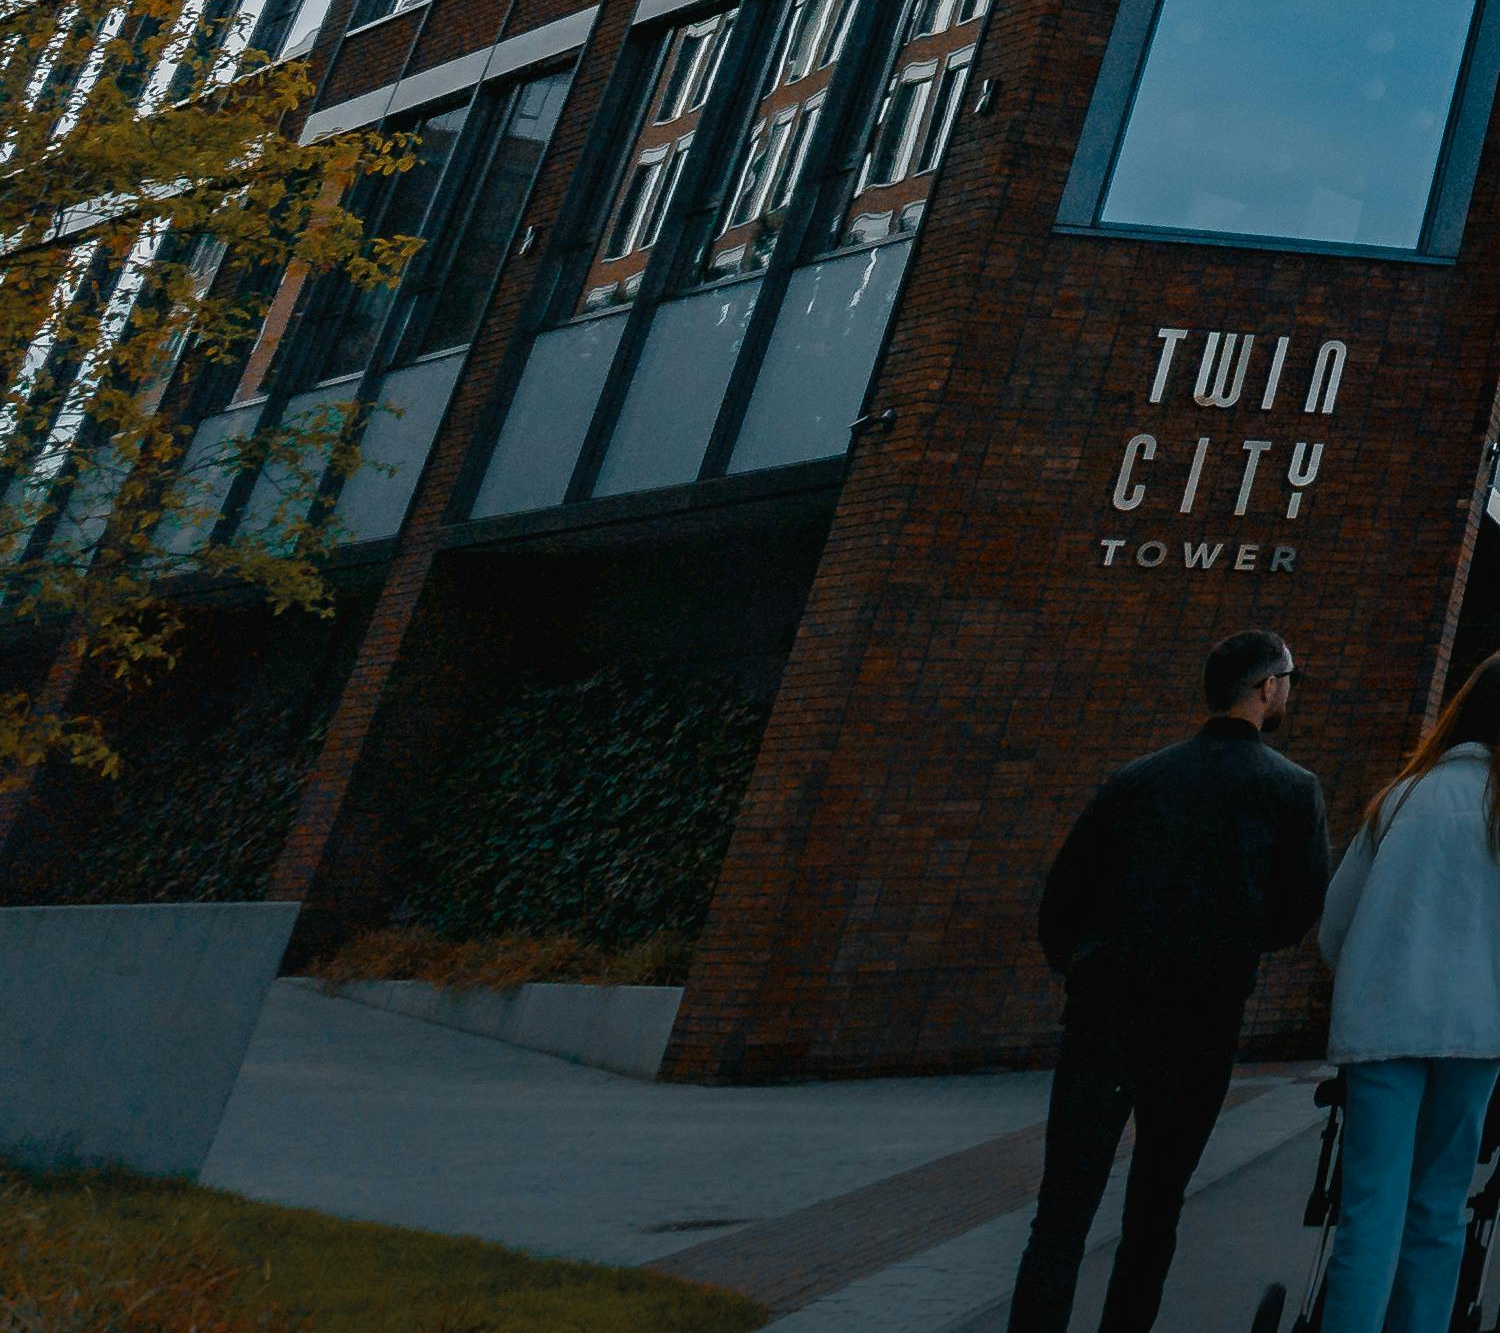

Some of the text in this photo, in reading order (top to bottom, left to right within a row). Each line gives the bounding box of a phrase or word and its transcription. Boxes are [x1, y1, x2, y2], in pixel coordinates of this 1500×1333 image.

[1149, 328, 1347, 414] TWIN
[1113, 434, 1324, 519] CITY
[1100, 539, 1297, 573] TOWER
